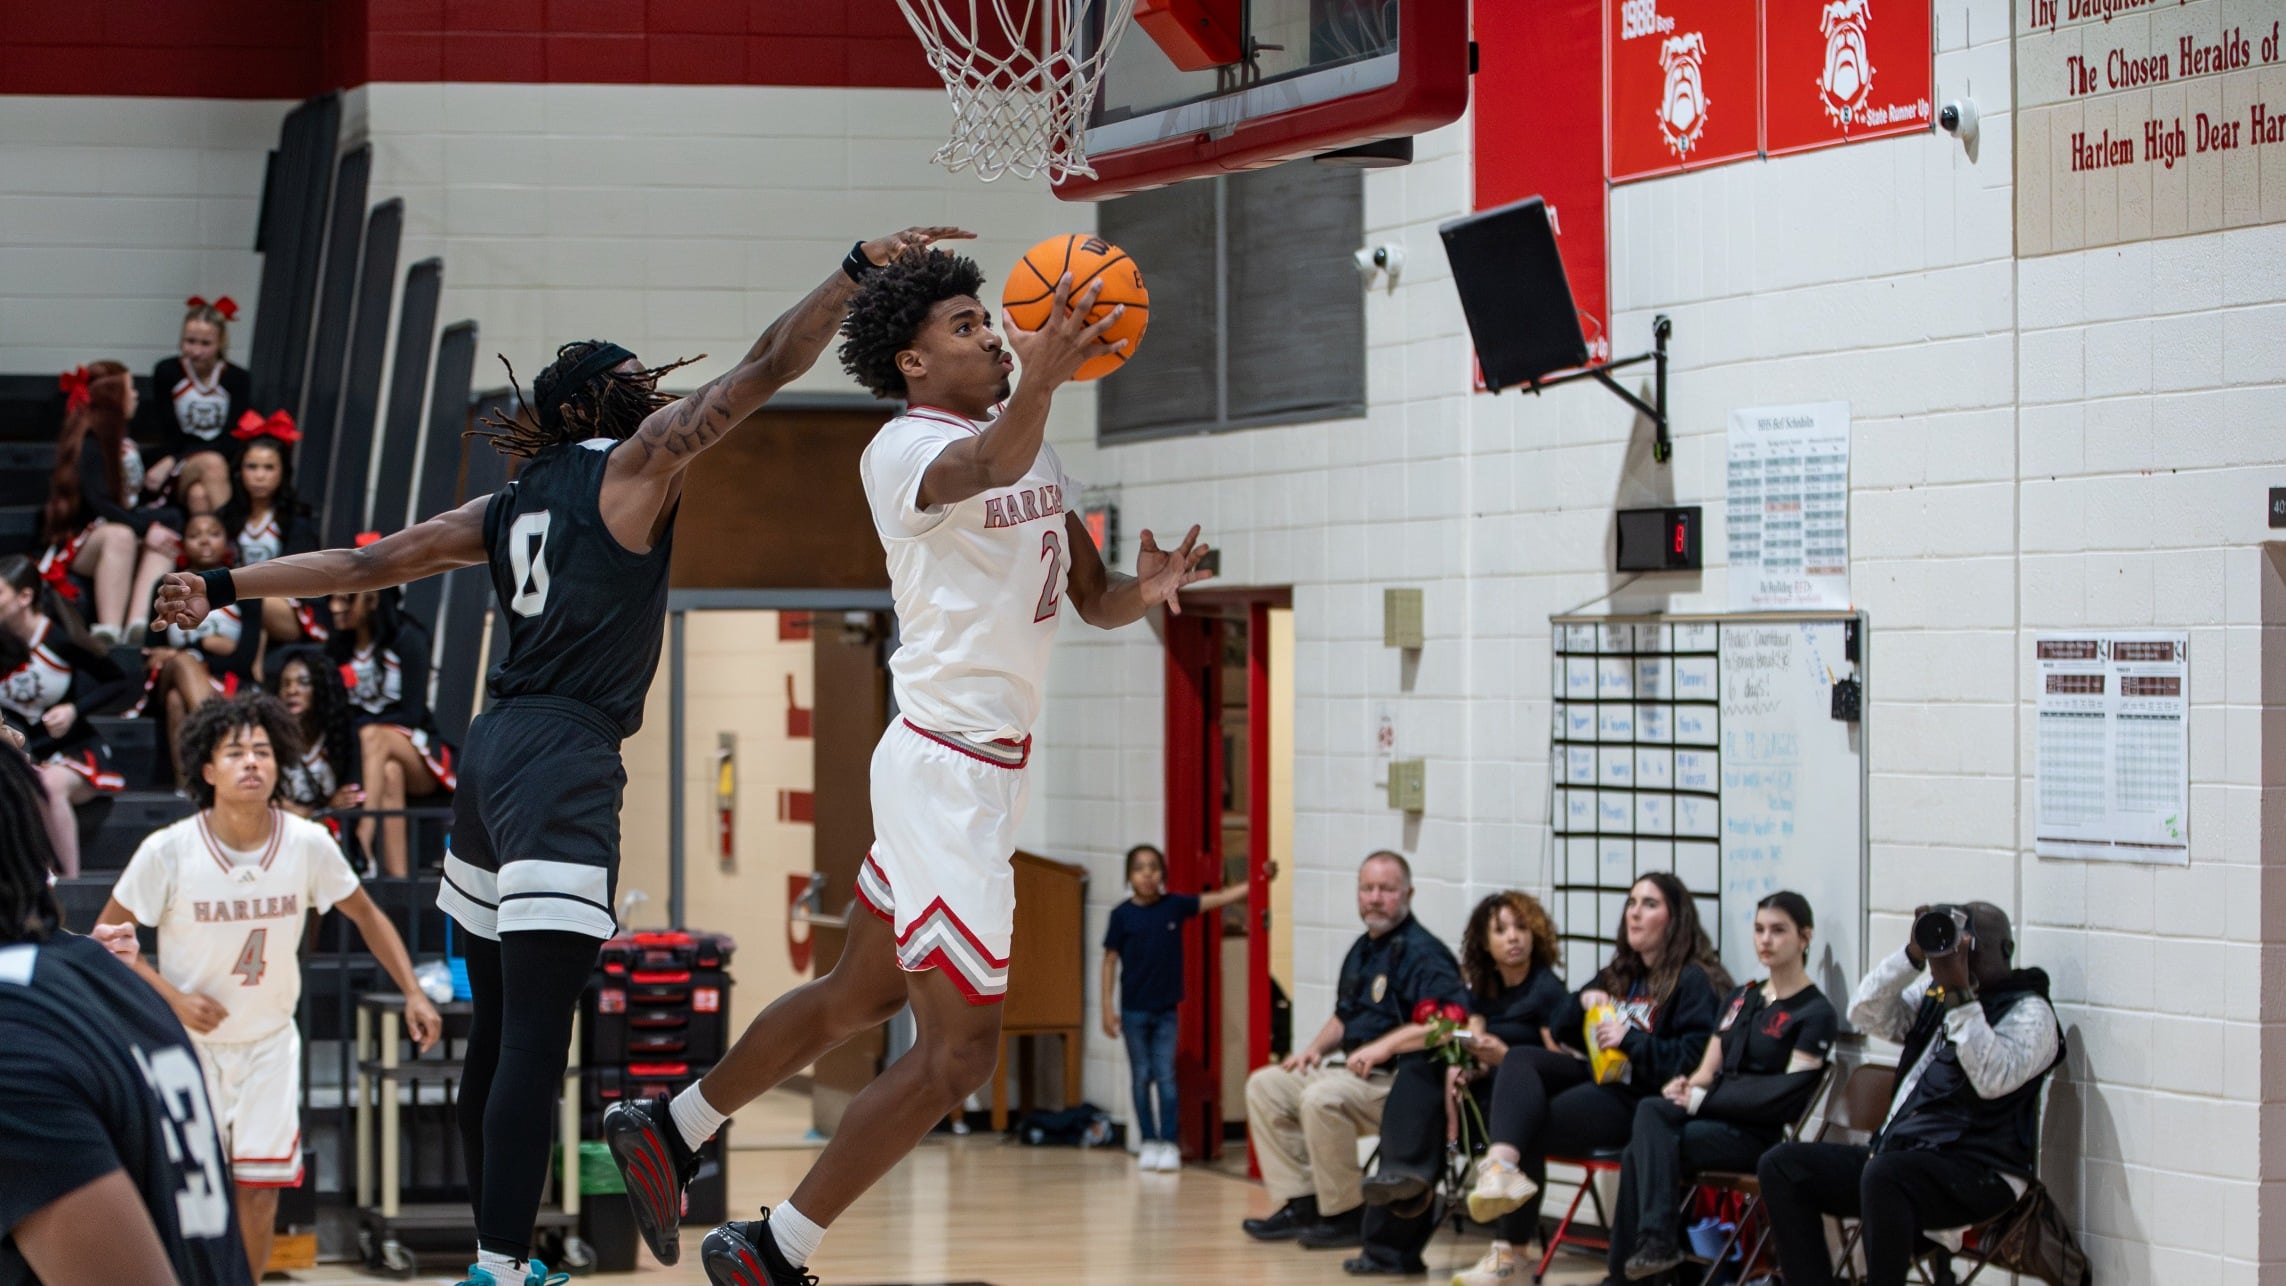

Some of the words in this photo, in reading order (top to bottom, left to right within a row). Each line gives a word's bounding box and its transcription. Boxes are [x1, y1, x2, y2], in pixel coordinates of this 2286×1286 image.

[1621, 0, 1656, 40] 1988
[2066, 55, 2097, 96] The
[2107, 47, 2169, 90] Chosen
[2179, 26, 2251, 77] Heralds
[2261, 20, 2279, 63] of
[1866, 107, 1888, 127] State
[1888, 103, 1917, 123] Runner
[1917, 97, 1929, 120] Up
[2071, 128, 2134, 172] Harlem
[2144, 116, 2186, 170] High
[2195, 112, 2240, 153] Dear
[984, 485, 1064, 528] HARLE
[2274, 500, 2286, 515] 40
[510, 509, 550, 618] 0
[1034, 530, 1061, 624] 2
[193, 893, 298, 922] HARLEM
[231, 928, 267, 986] 4
